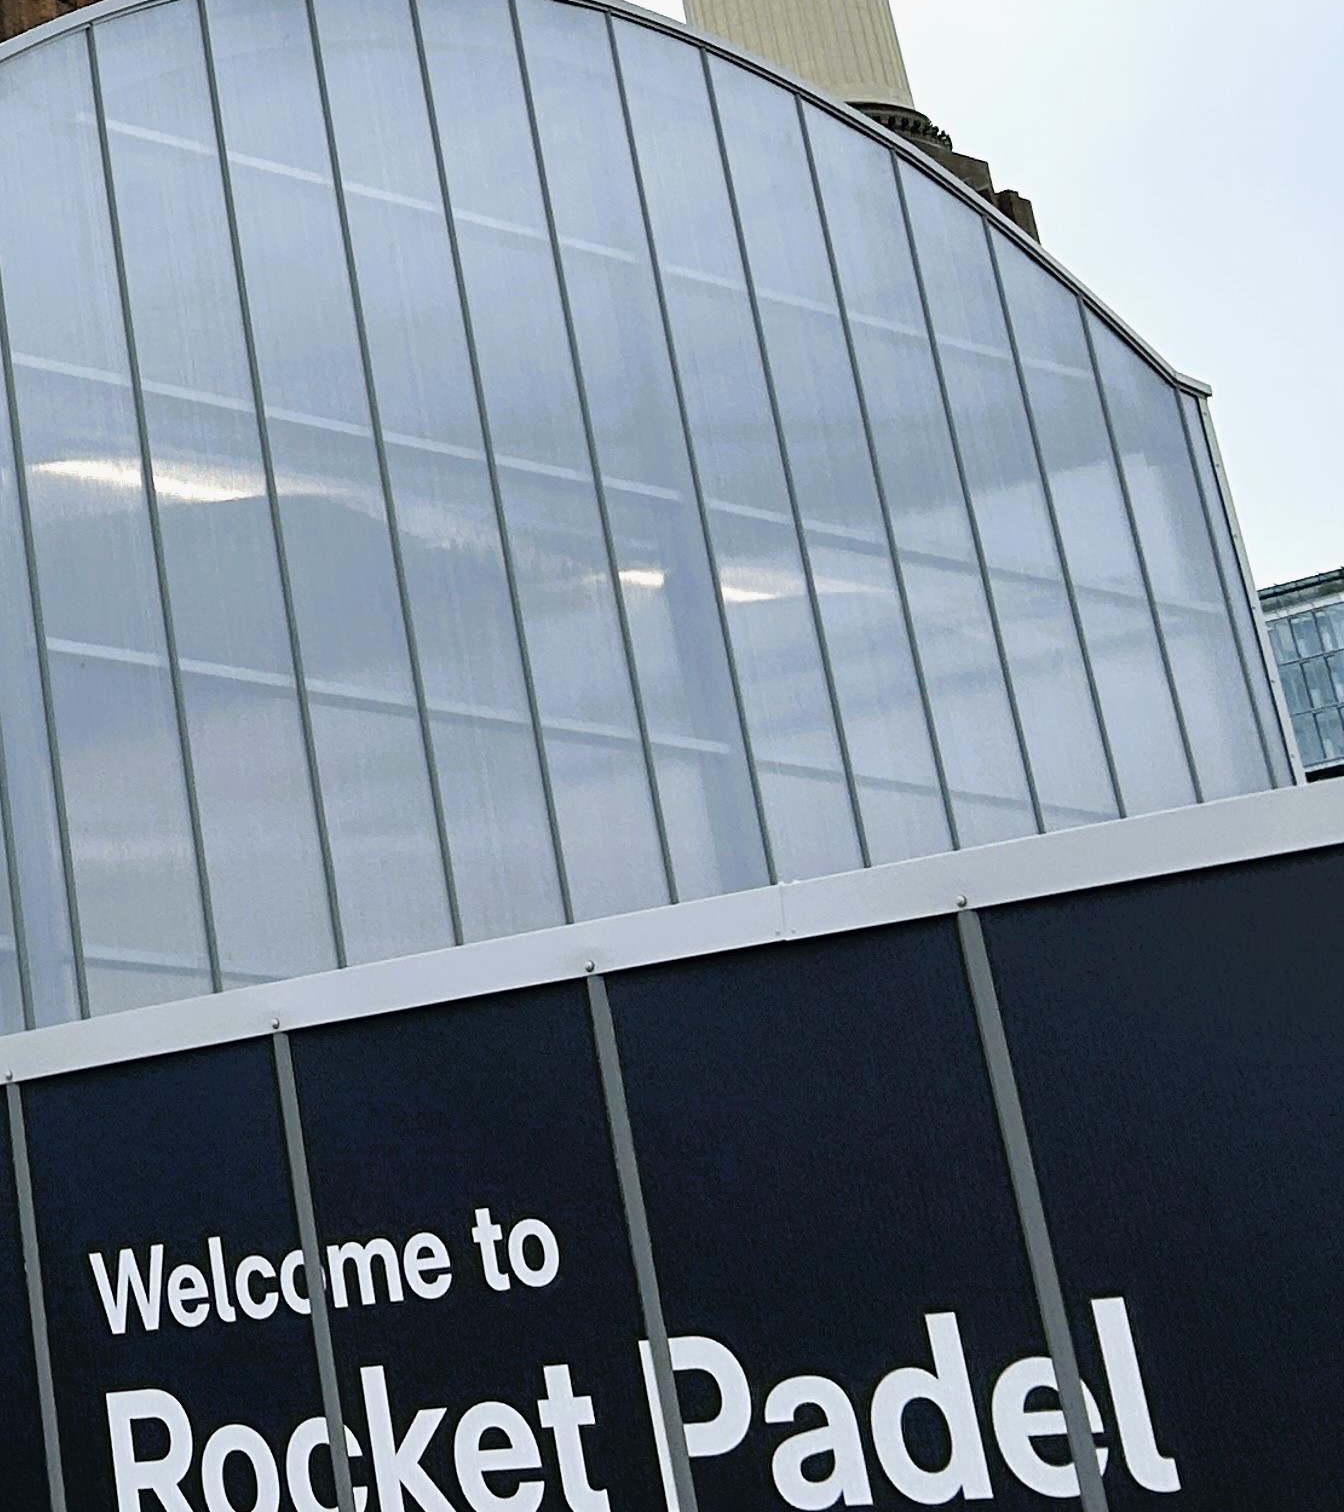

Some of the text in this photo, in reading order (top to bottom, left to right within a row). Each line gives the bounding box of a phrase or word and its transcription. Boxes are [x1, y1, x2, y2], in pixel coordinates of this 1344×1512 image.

[88, 1207, 560, 1335] Welcome to
[106, 1296, 1182, 1512] Rocket Padel
